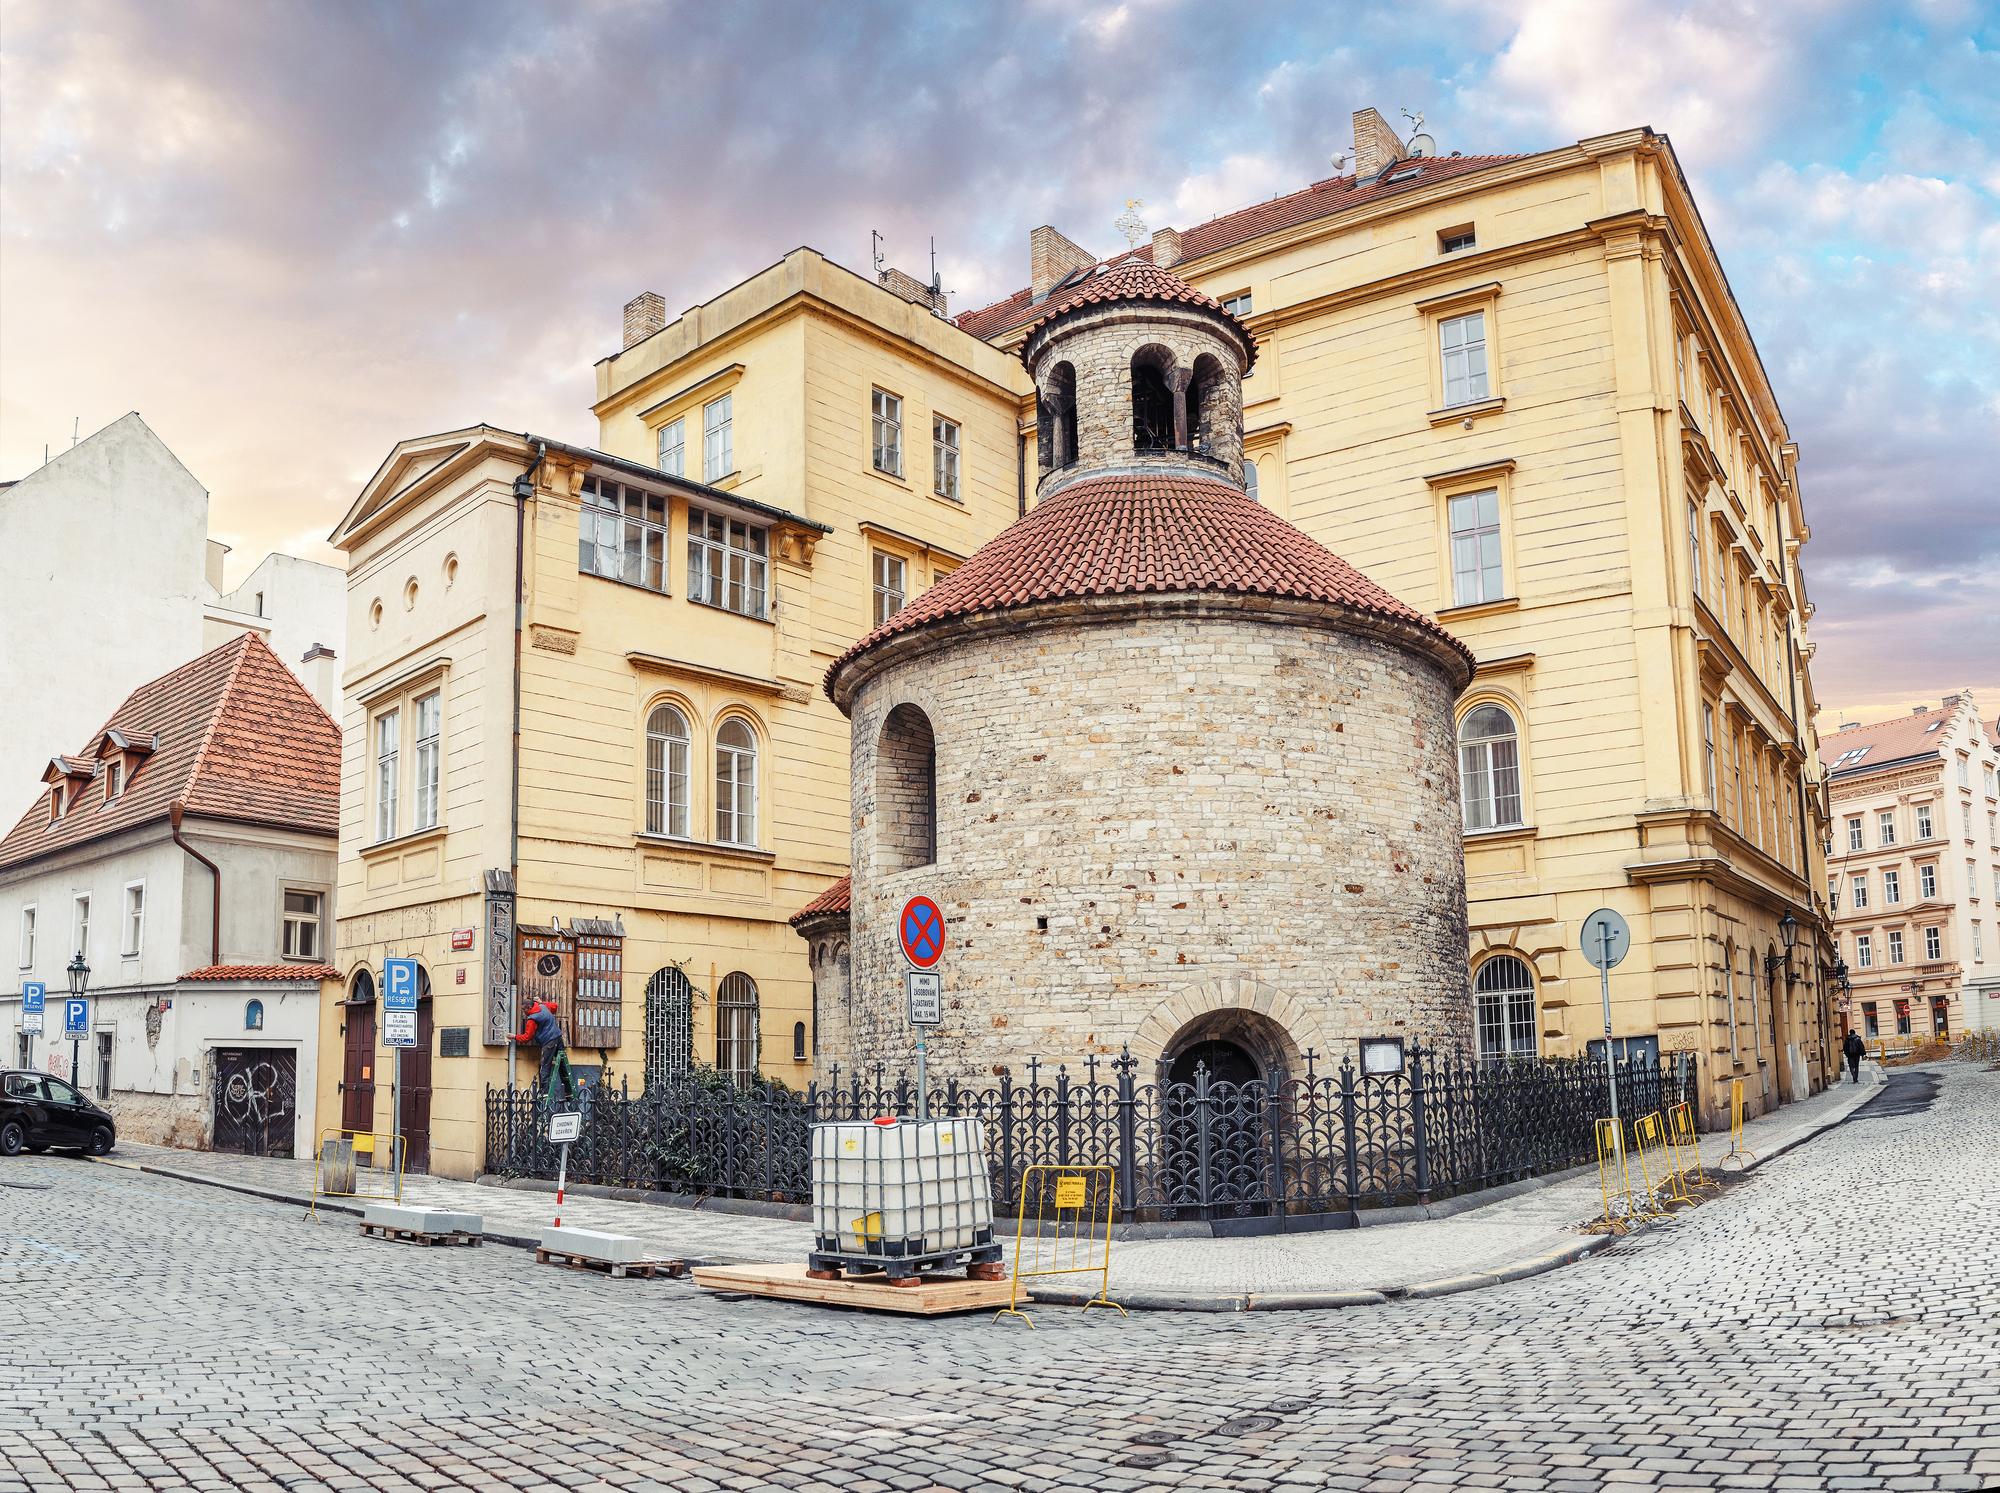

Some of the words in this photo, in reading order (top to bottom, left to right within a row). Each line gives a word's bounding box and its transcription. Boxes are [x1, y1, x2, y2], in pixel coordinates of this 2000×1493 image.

[391, 964, 410, 993] P
[919, 977, 930, 985] MIMO
[27, 985, 41, 1003] P
[70, 1003, 84, 1022] P
